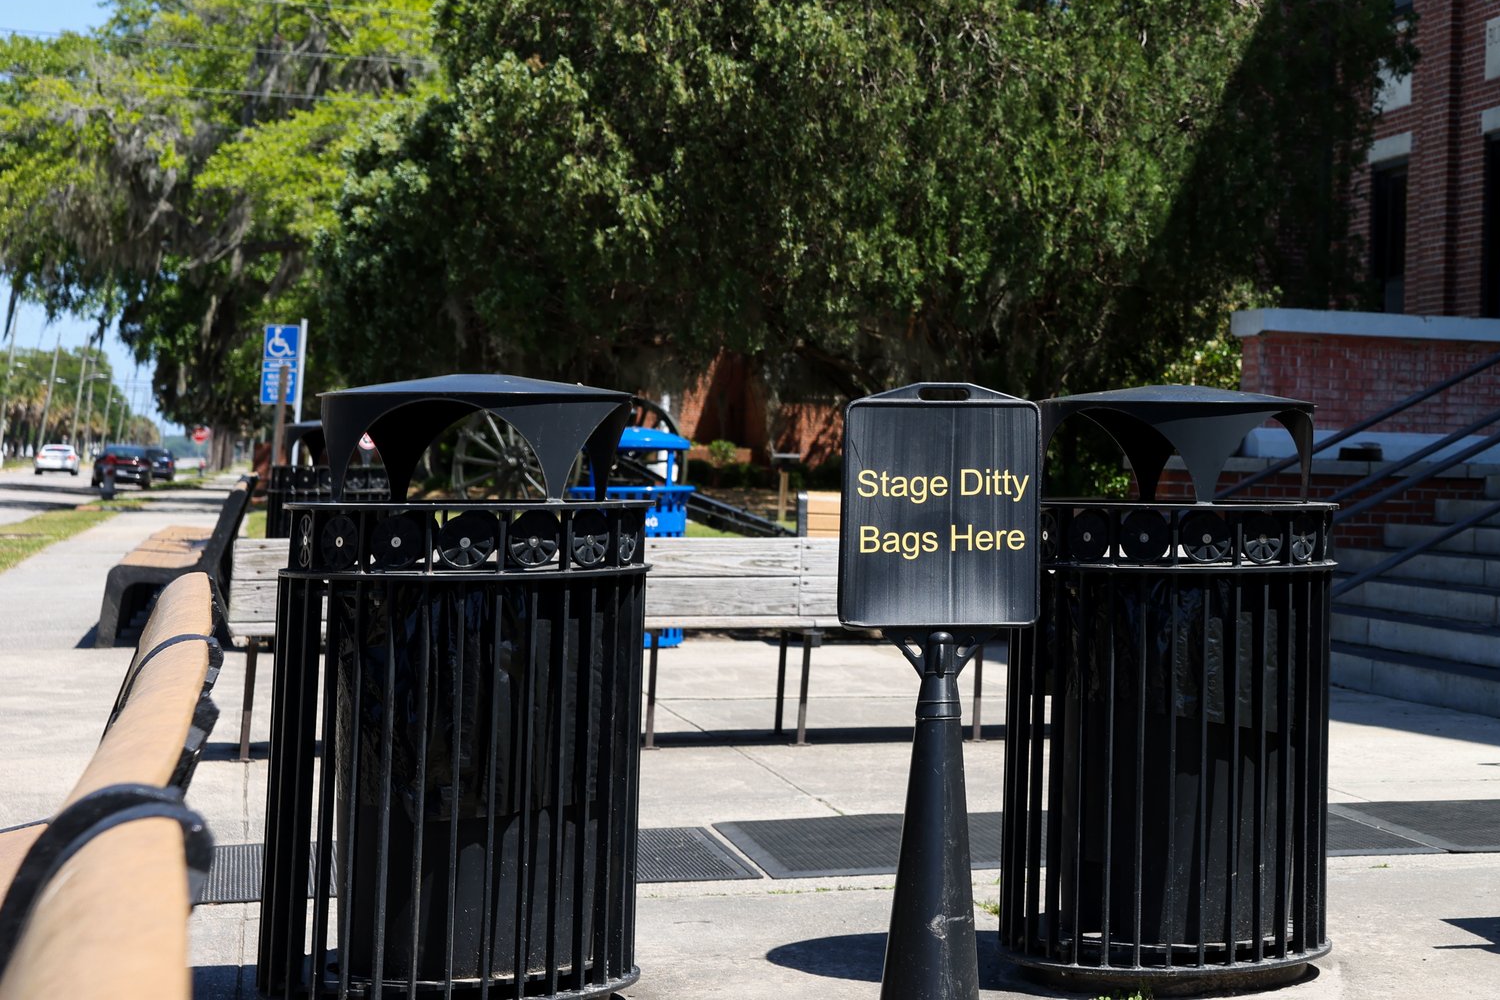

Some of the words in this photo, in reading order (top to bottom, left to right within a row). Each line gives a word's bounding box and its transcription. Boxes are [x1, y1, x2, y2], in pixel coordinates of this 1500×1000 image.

[857, 469, 948, 504] Stage
[960, 468, 1029, 502] Ditty
[859, 525, 938, 560] Bags
[951, 524, 1025, 551] Here
